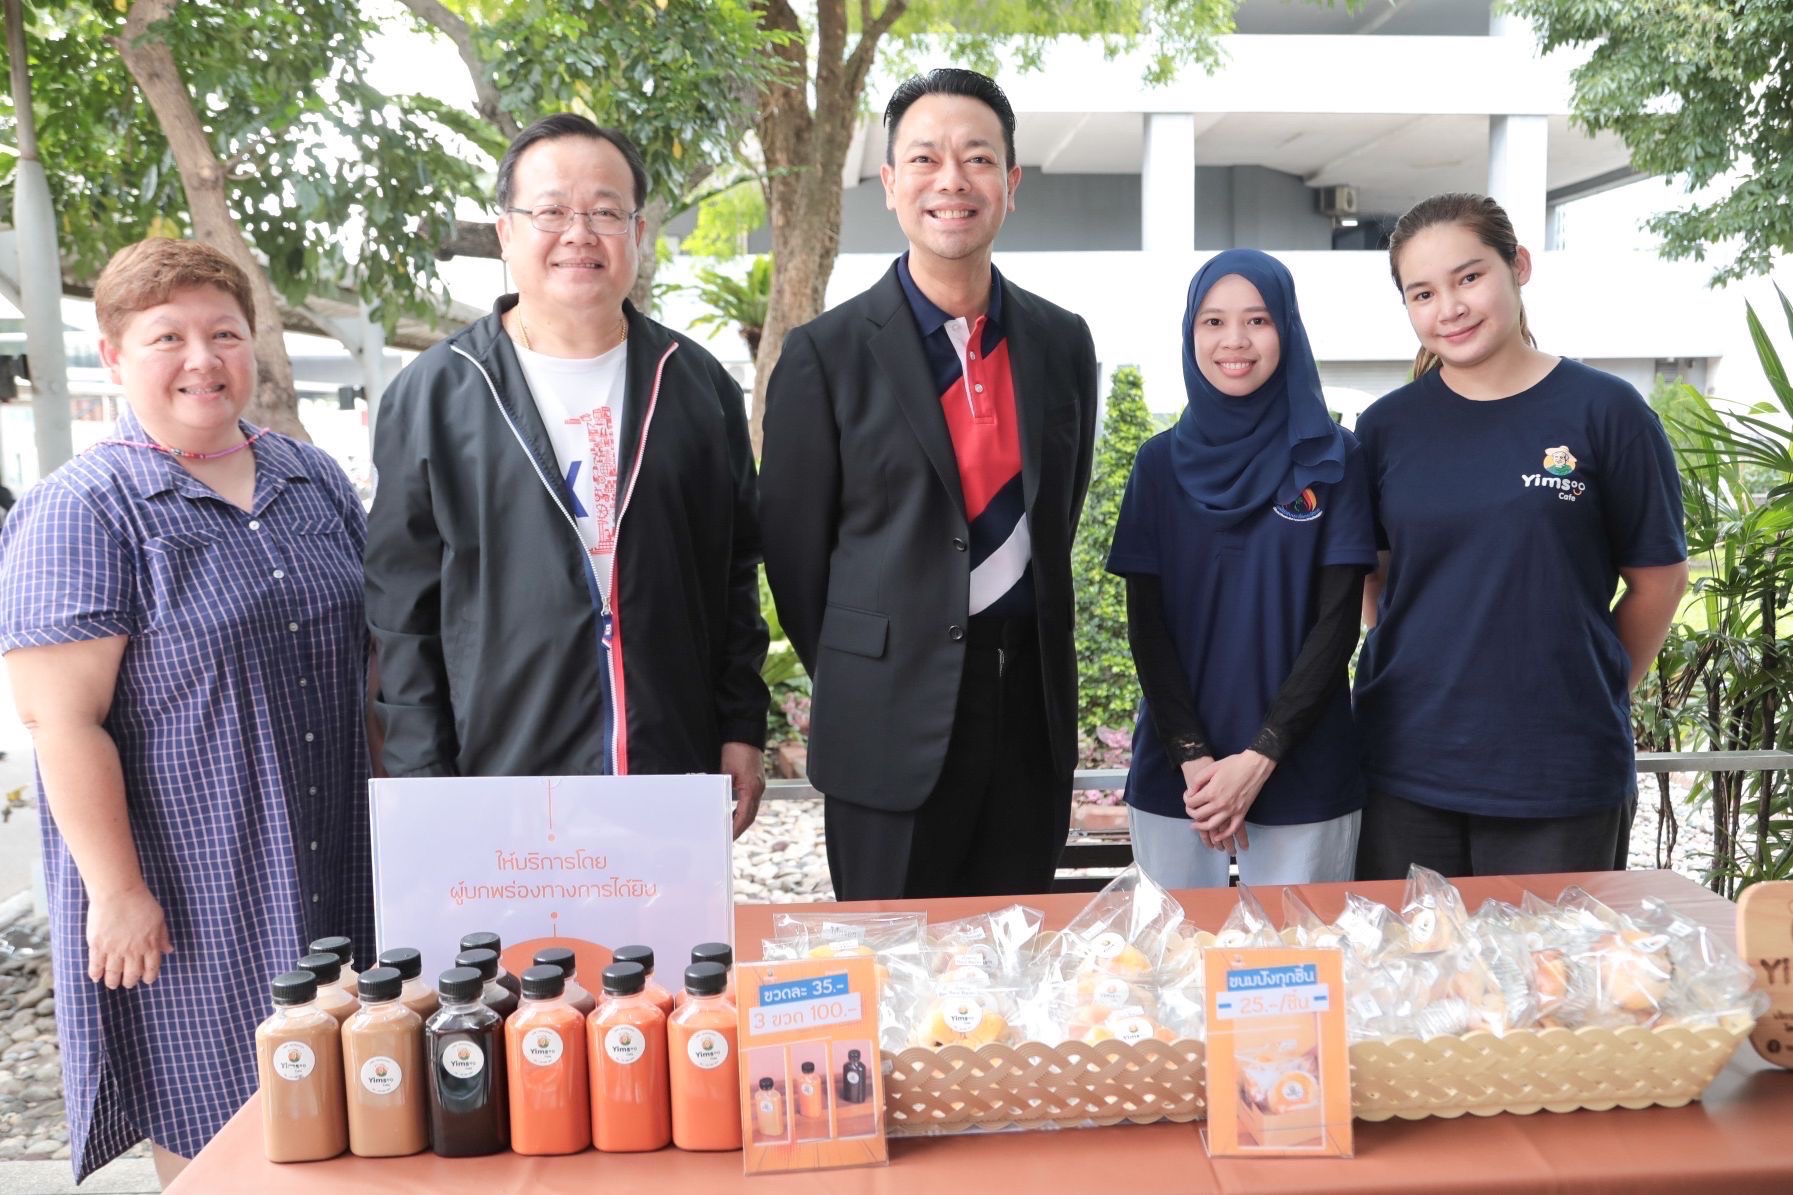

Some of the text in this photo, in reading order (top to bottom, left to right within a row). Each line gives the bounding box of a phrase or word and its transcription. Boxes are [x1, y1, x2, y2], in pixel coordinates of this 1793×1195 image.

[1521, 473, 1586, 491] Yimsoo
[1558, 492, 1576, 502] Cafe
[495, 848, 607, 871] ให้บริการโดย
[763, 978, 845, 1003] ขวดละ 35.-
[753, 1001, 858, 1030] 3 ขวด 100.-
